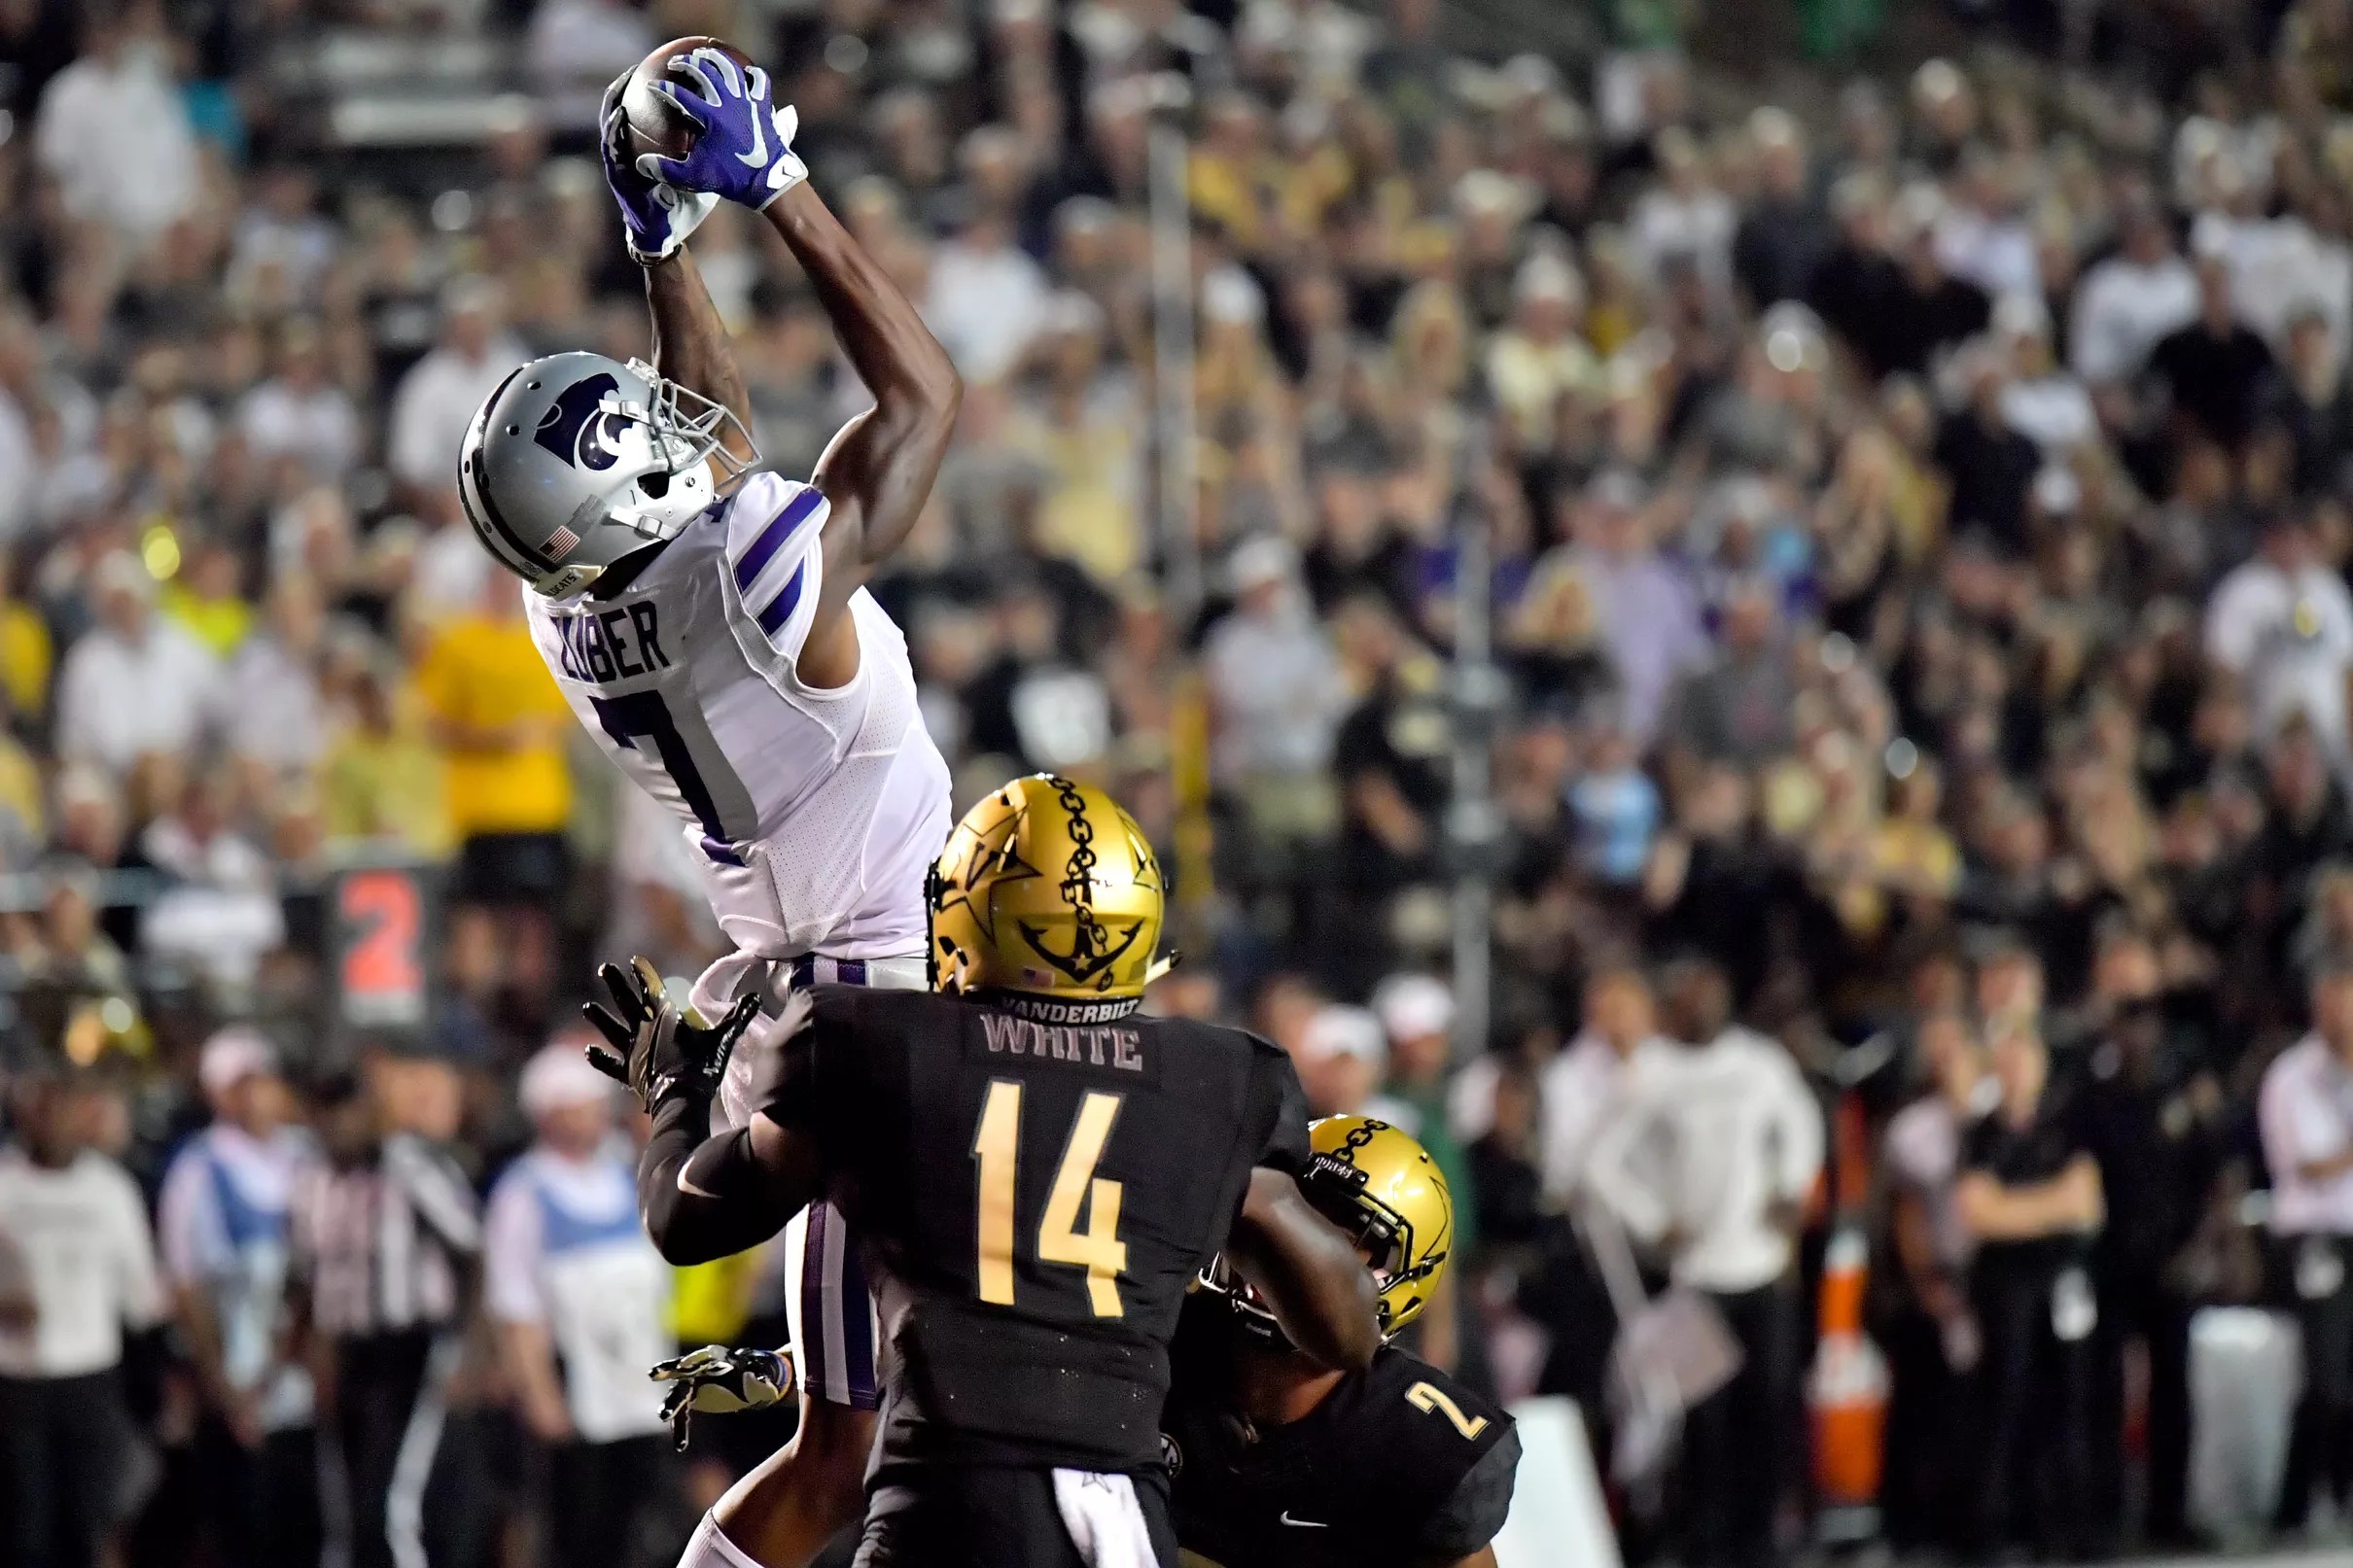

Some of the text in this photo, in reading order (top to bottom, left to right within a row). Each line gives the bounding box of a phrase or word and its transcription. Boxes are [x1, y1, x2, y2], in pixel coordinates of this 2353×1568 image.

[587, 689, 746, 867] 7
[342, 870, 423, 993] 2
[979, 1013, 1143, 1071] WHITE
[1001, 995, 1140, 1025] VANDERBILT
[972, 1079, 1127, 1318] 14
[1405, 1380, 1492, 1442] 2
